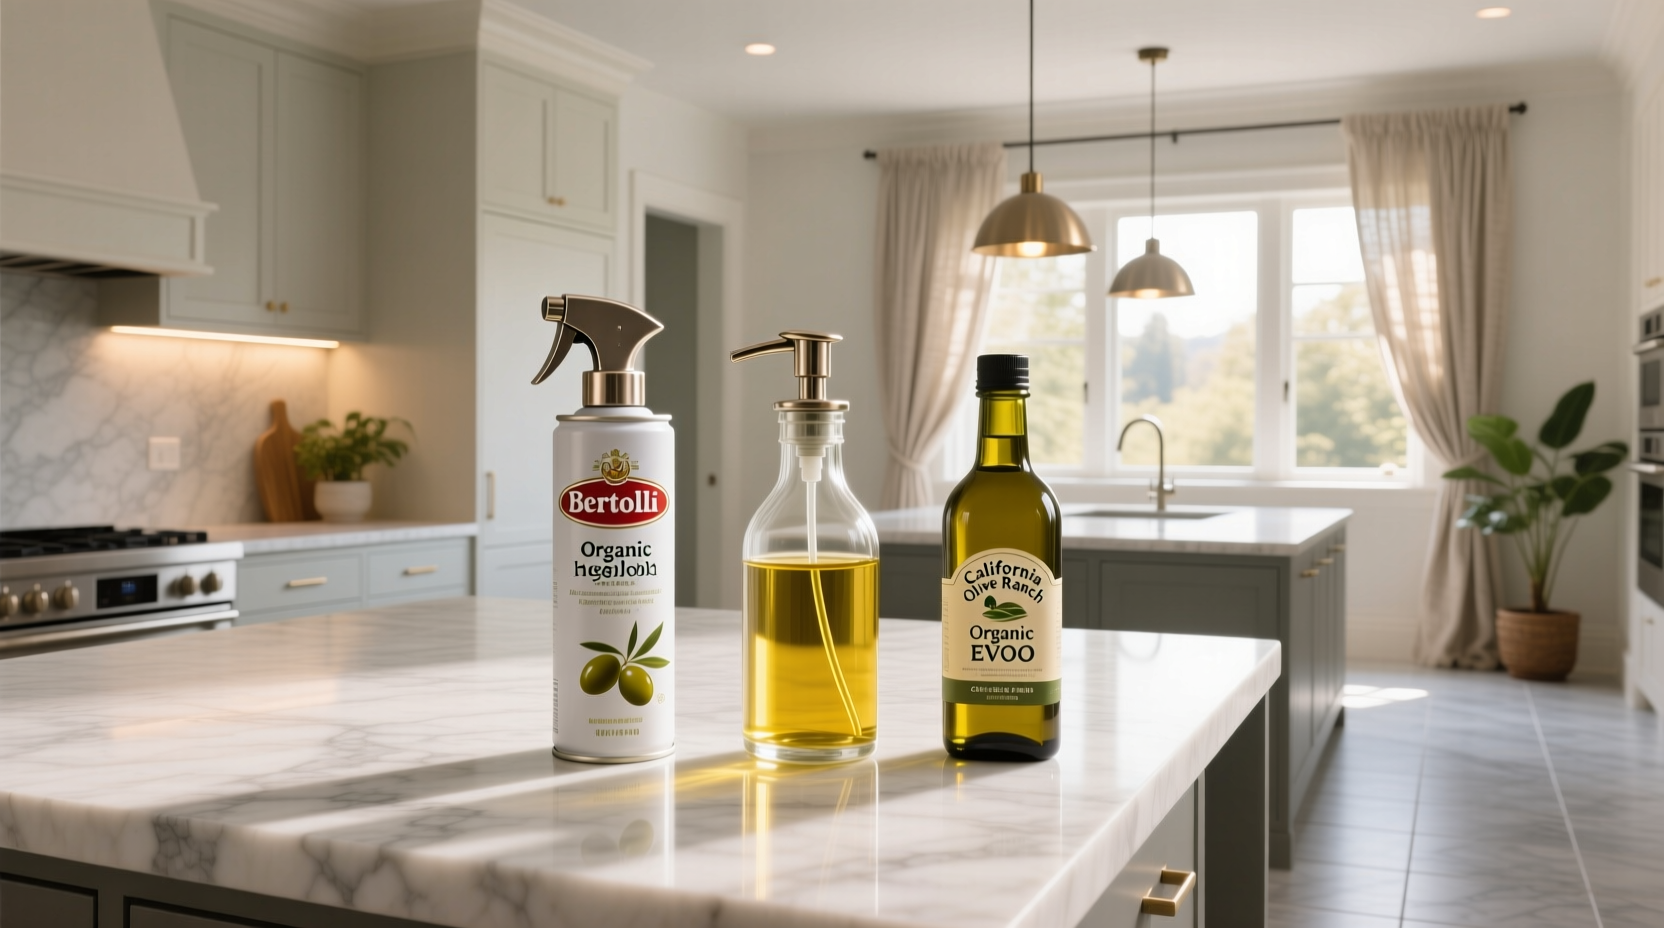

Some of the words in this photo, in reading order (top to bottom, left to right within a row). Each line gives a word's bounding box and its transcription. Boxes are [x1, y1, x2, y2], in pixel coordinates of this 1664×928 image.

[568, 490, 659, 513] Bertolli
[581, 541, 652, 563] Organic
[964, 560, 1042, 586] California
[963, 579, 998, 602] Olive
[1002, 576, 1044, 604] Ranch
[969, 625, 1034, 645] Organic
[971, 644, 1035, 662] EVOO
